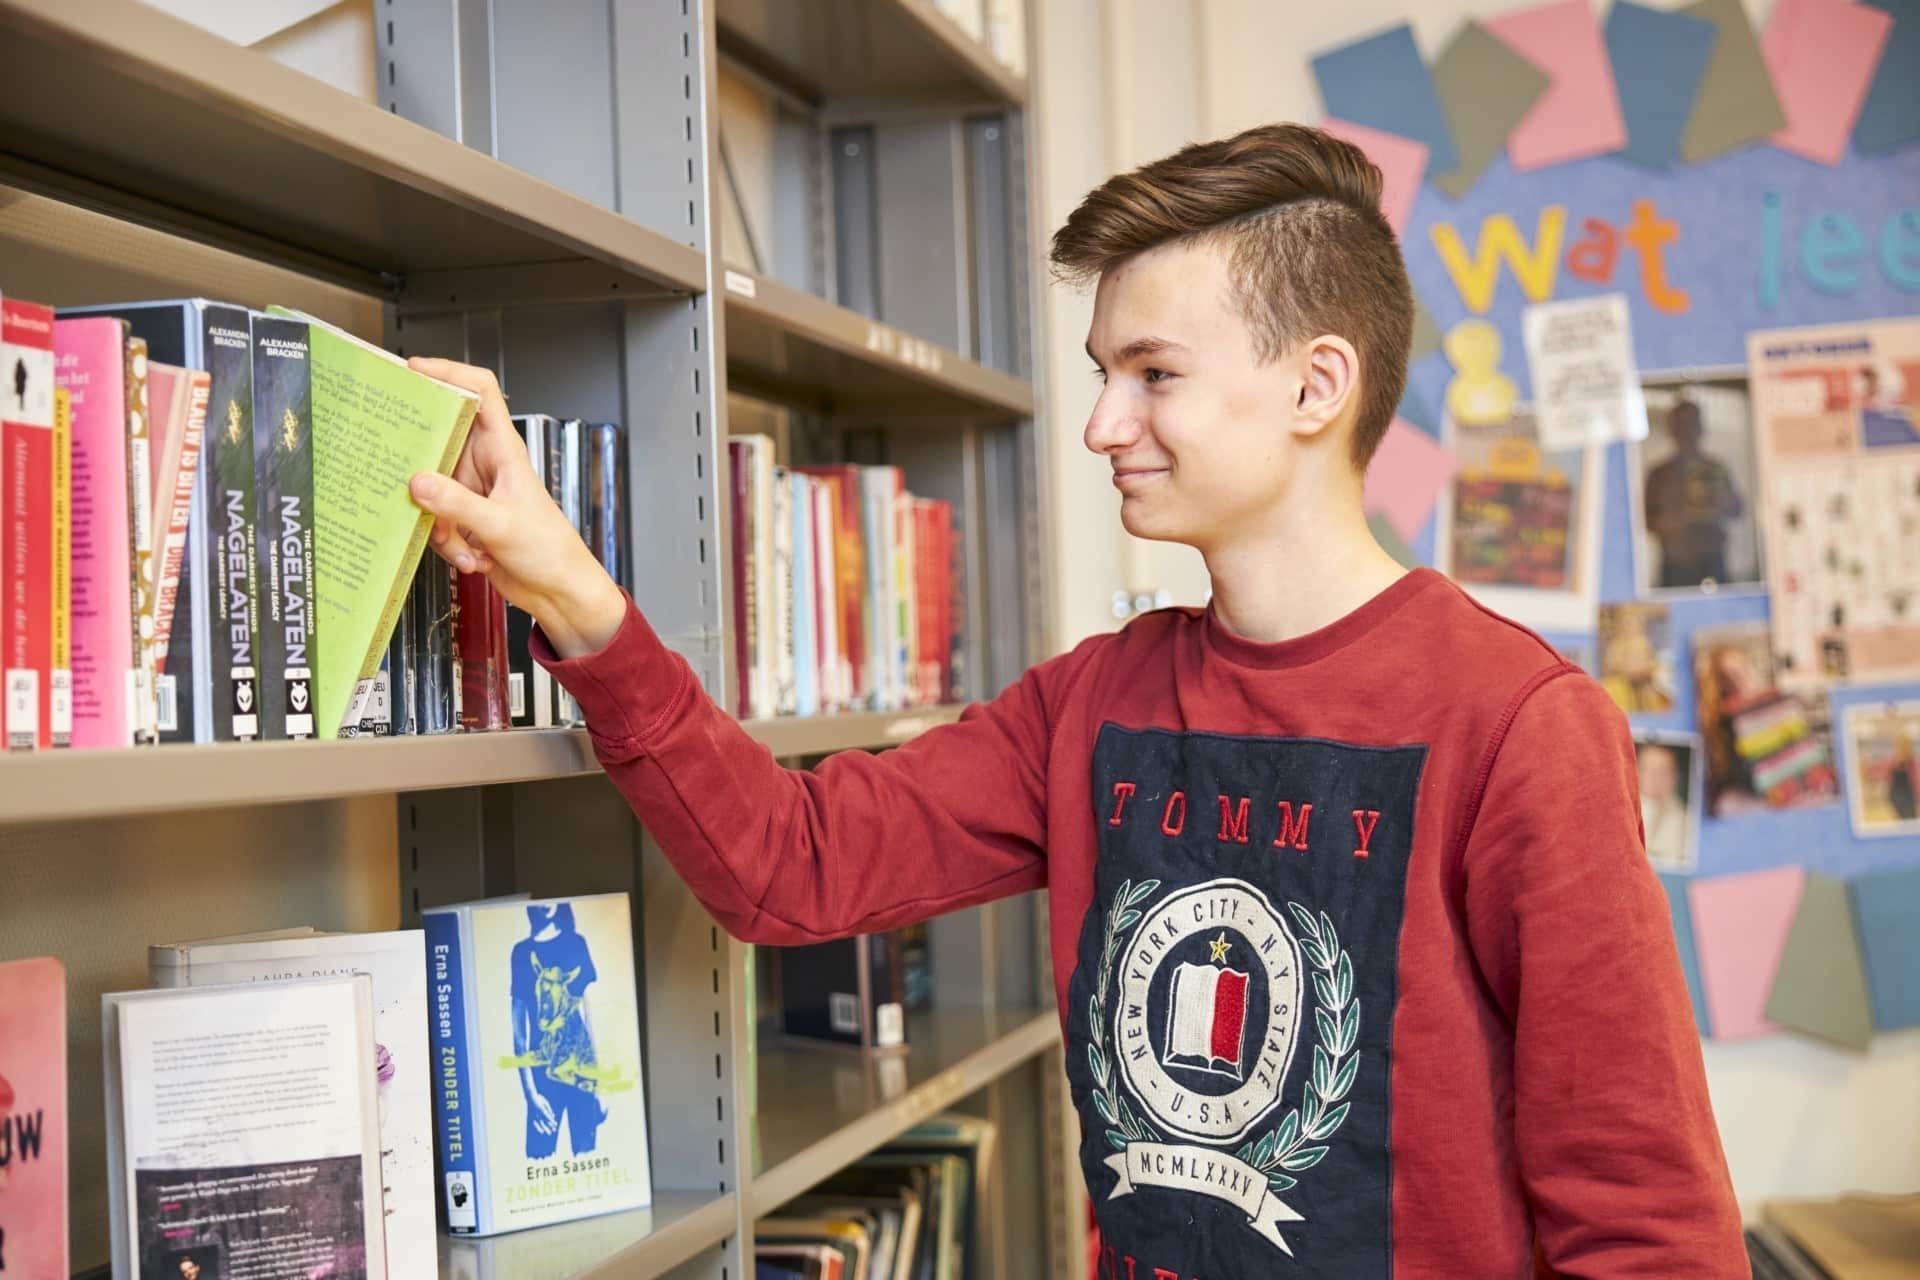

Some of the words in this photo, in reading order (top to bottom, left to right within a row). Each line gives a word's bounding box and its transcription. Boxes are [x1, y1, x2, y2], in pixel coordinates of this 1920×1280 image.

[208, 326, 250, 340] ALEXANDRA
[213, 336, 248, 349] BRACKEN
[259, 337, 309, 352] ALEXANDRA
[265, 347, 304, 360] BRACKEN
[183, 387, 210, 446] BLAUW
[181, 450, 199, 467] IS
[171, 469, 195, 527] BITTER
[304, 528, 312, 550] THE
[163, 545, 183, 579] DIRK
[226, 489, 250, 665] NAGELATEN
[248, 547, 256, 596] DARKEST
[271, 557, 279, 594] DARKEST
[281, 496, 307, 665] NAGELATEN
[304, 552, 313, 599] DARKEST
[249, 599, 258, 634] MINDS
[272, 595, 280, 622] LEGACY
[306, 601, 315, 635] MINDS
[1109, 782, 1381, 859] TOMMY
[1193, 899, 1239, 923] CITY
[434, 944, 449, 980] Erna
[1131, 917, 1179, 982] YORK
[437, 983, 451, 1038] Sassen
[1127, 1004, 1148, 1062] NEW
[1256, 1004, 1288, 1089] STATE
[442, 1046, 459, 1111] ZONDER
[447, 1117, 461, 1163] TITEL
[504, 1177, 578, 1205] ZONDER
[585, 1168, 634, 1188] TITEL
[527, 1165, 559, 1181] Erna
[563, 1156, 611, 1175] Sassen
[1141, 1151, 1252, 1197] MCMLXXXV
